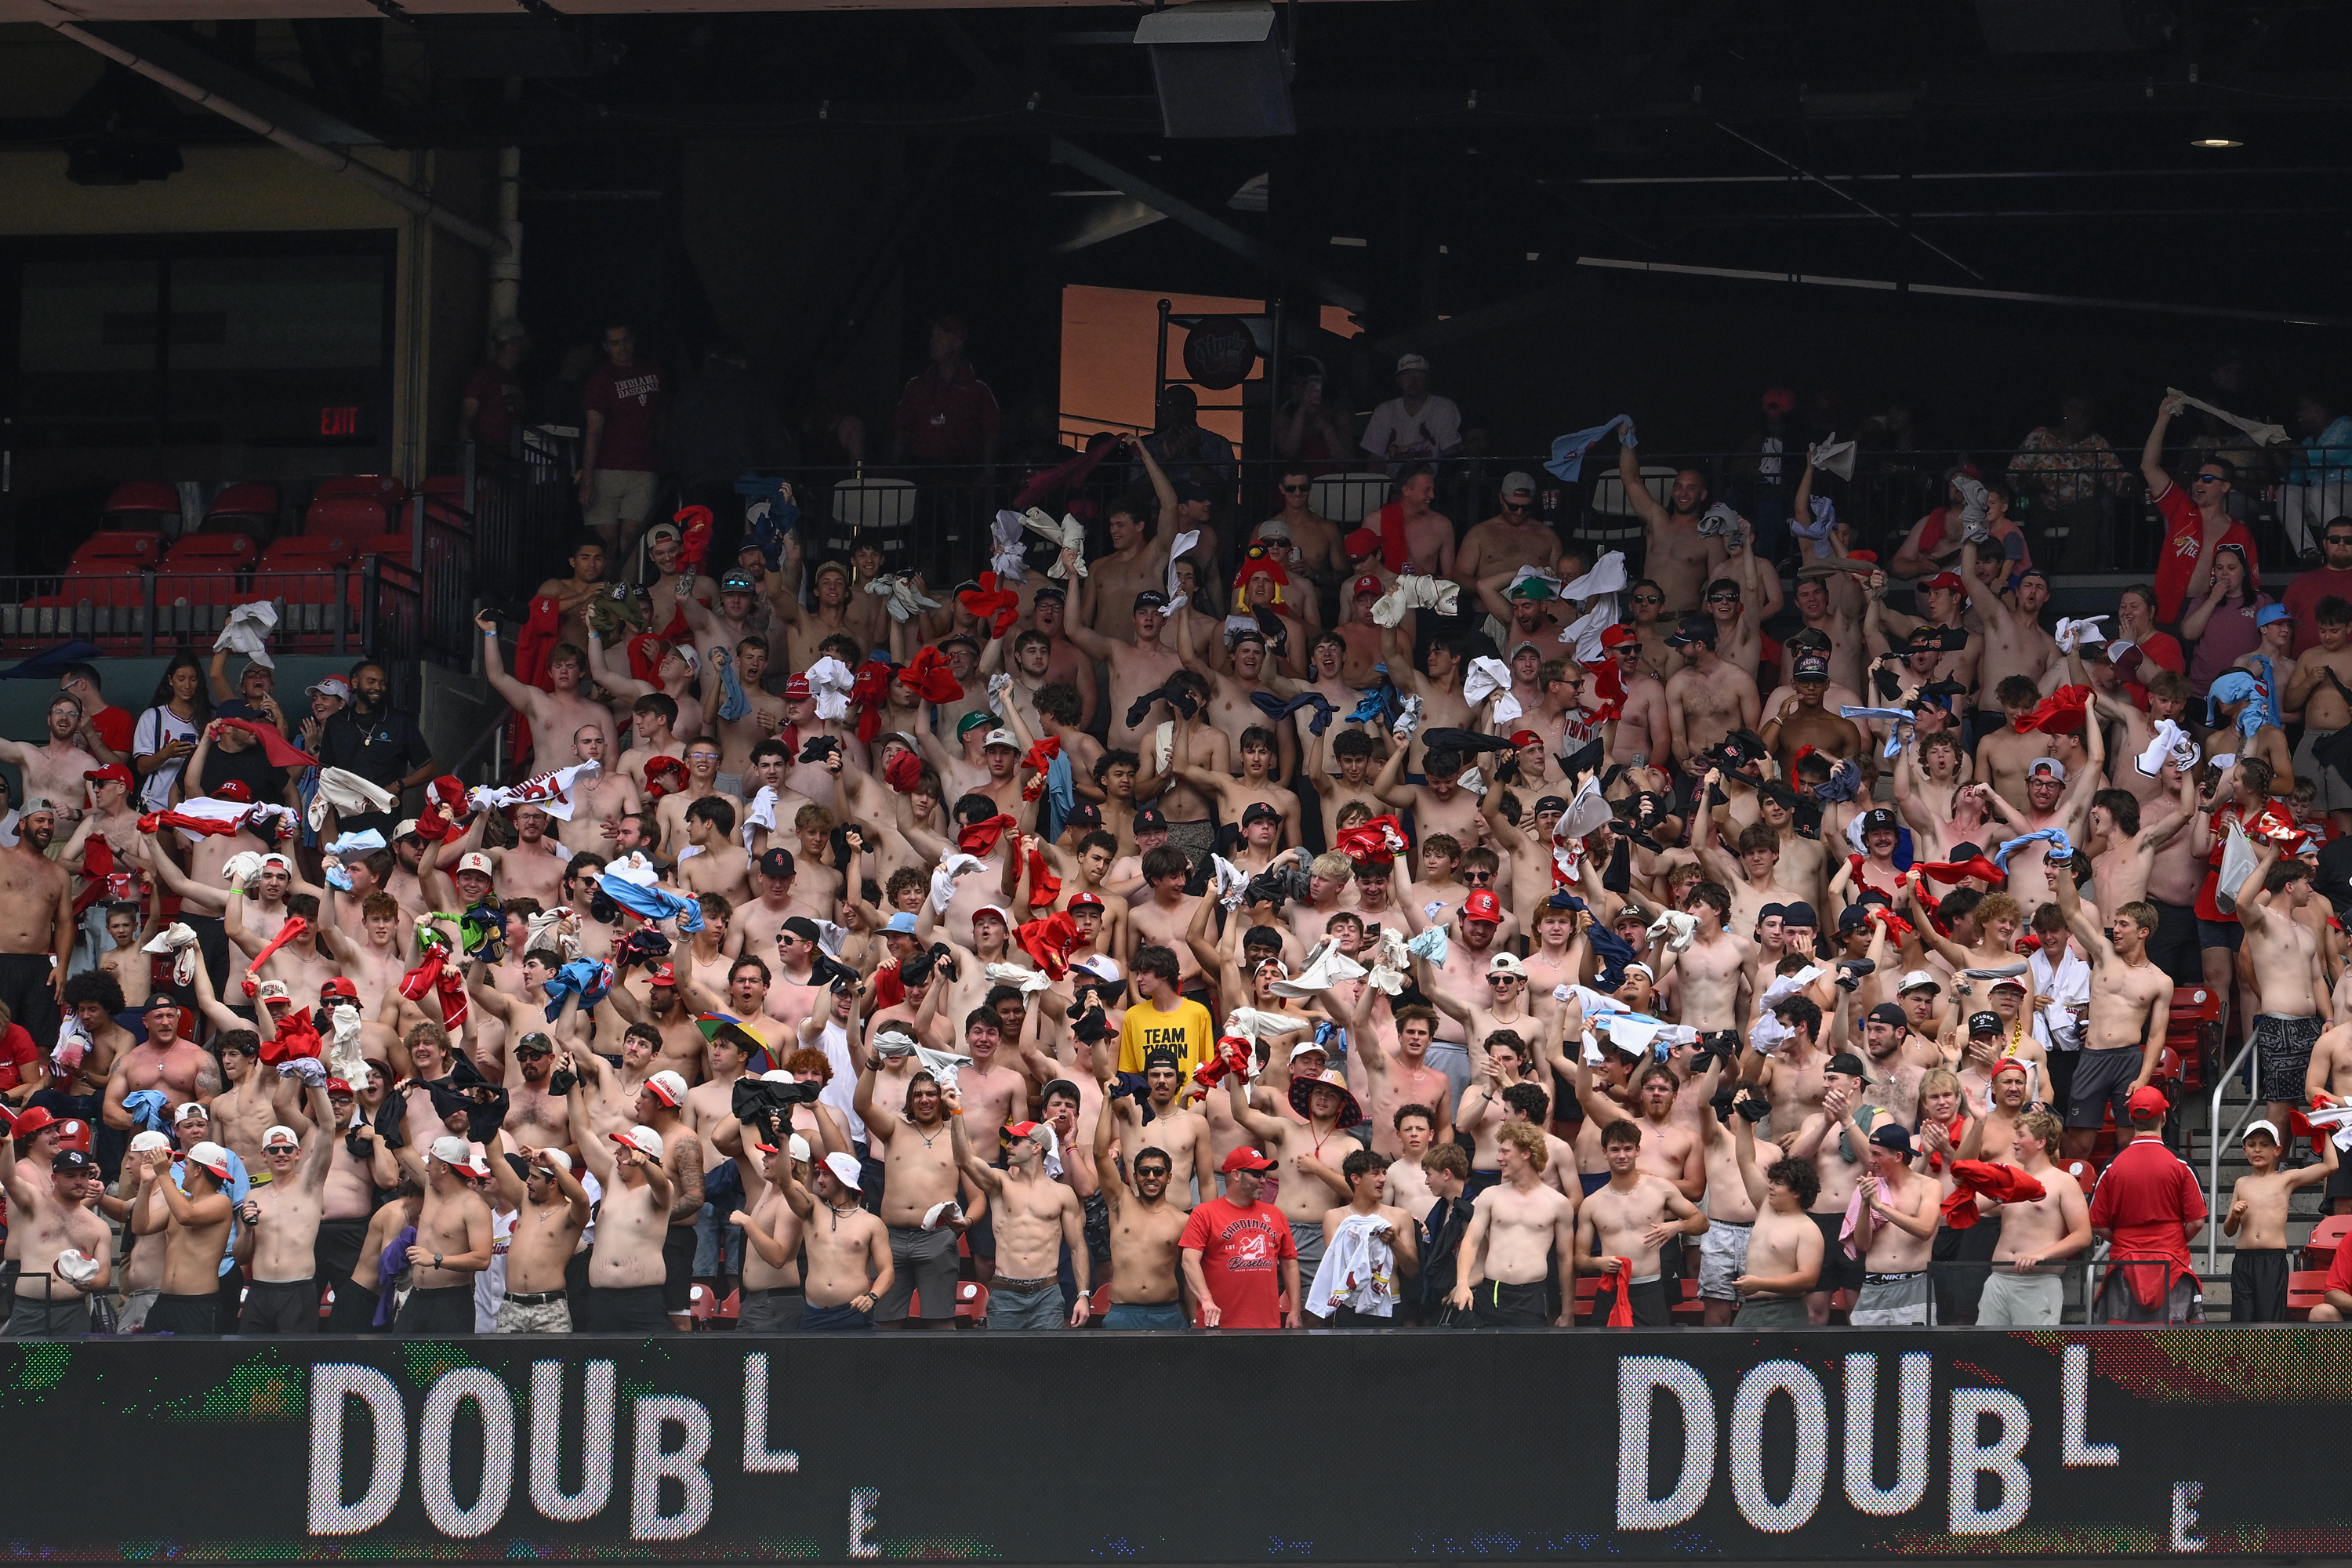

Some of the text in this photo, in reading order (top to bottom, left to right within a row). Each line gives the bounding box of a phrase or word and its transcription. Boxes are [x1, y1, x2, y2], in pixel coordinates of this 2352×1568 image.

[615, 373, 659, 390] INDIANA
[618, 383, 659, 399] BASEBALL
[321, 406, 358, 434] EXIT
[2175, 535, 2200, 558] The
[1799, 657, 1825, 670] CARDINALS
[221, 782, 238, 791] STL
[261, 985, 284, 995] ARDINALS
[1972, 1014, 1995, 1024] SEAGER
[1144, 1027, 1185, 1044] TEAM
[1142, 1043, 1188, 1059] TYON
[655, 1076, 677, 1098] CARDINALS
[1221, 1219, 1278, 1241] CARDINALS
[1881, 1272, 1907, 1282] NIKE
